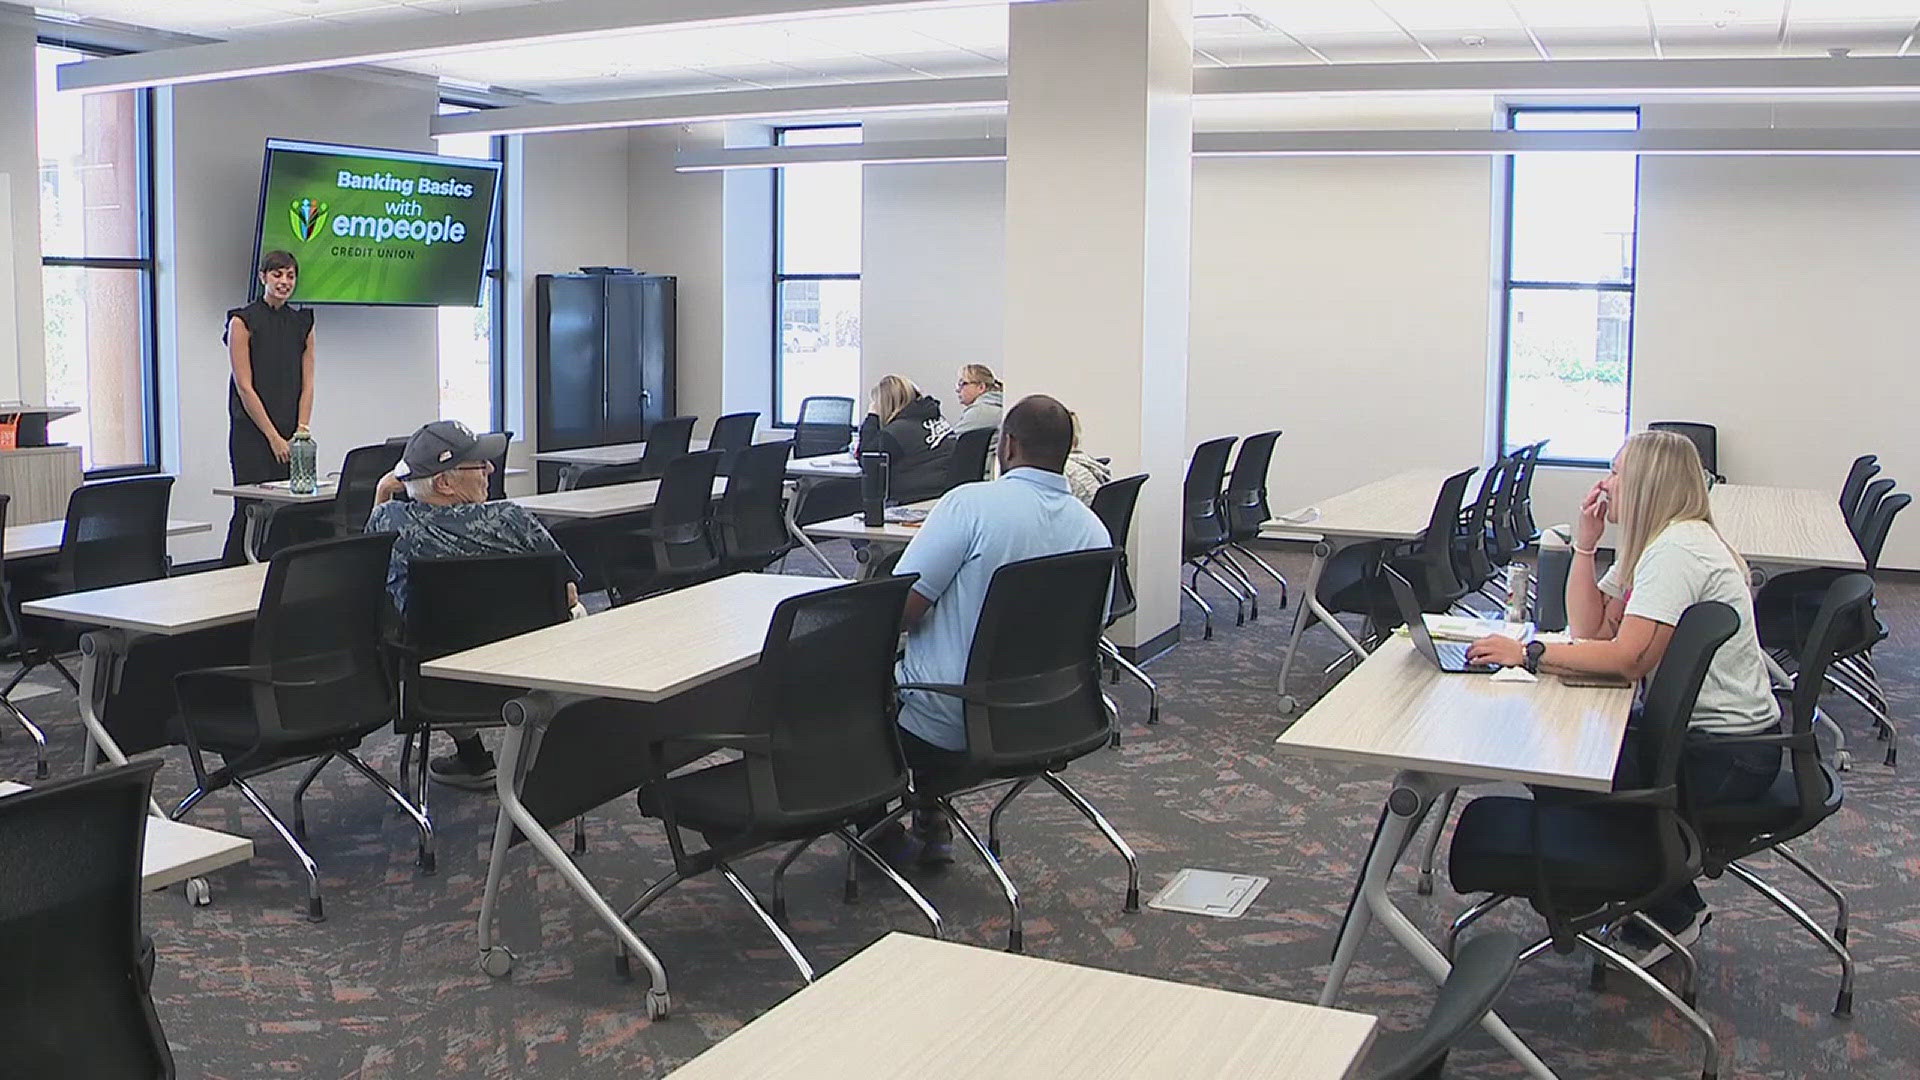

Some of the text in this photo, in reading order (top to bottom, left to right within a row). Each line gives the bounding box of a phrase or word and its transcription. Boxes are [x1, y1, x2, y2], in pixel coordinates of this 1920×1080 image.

[337, 170, 474, 197] Banking Basics
[385, 200, 422, 216] with
[332, 214, 466, 245] empeople
[331, 246, 415, 259] CREDIT UNION
